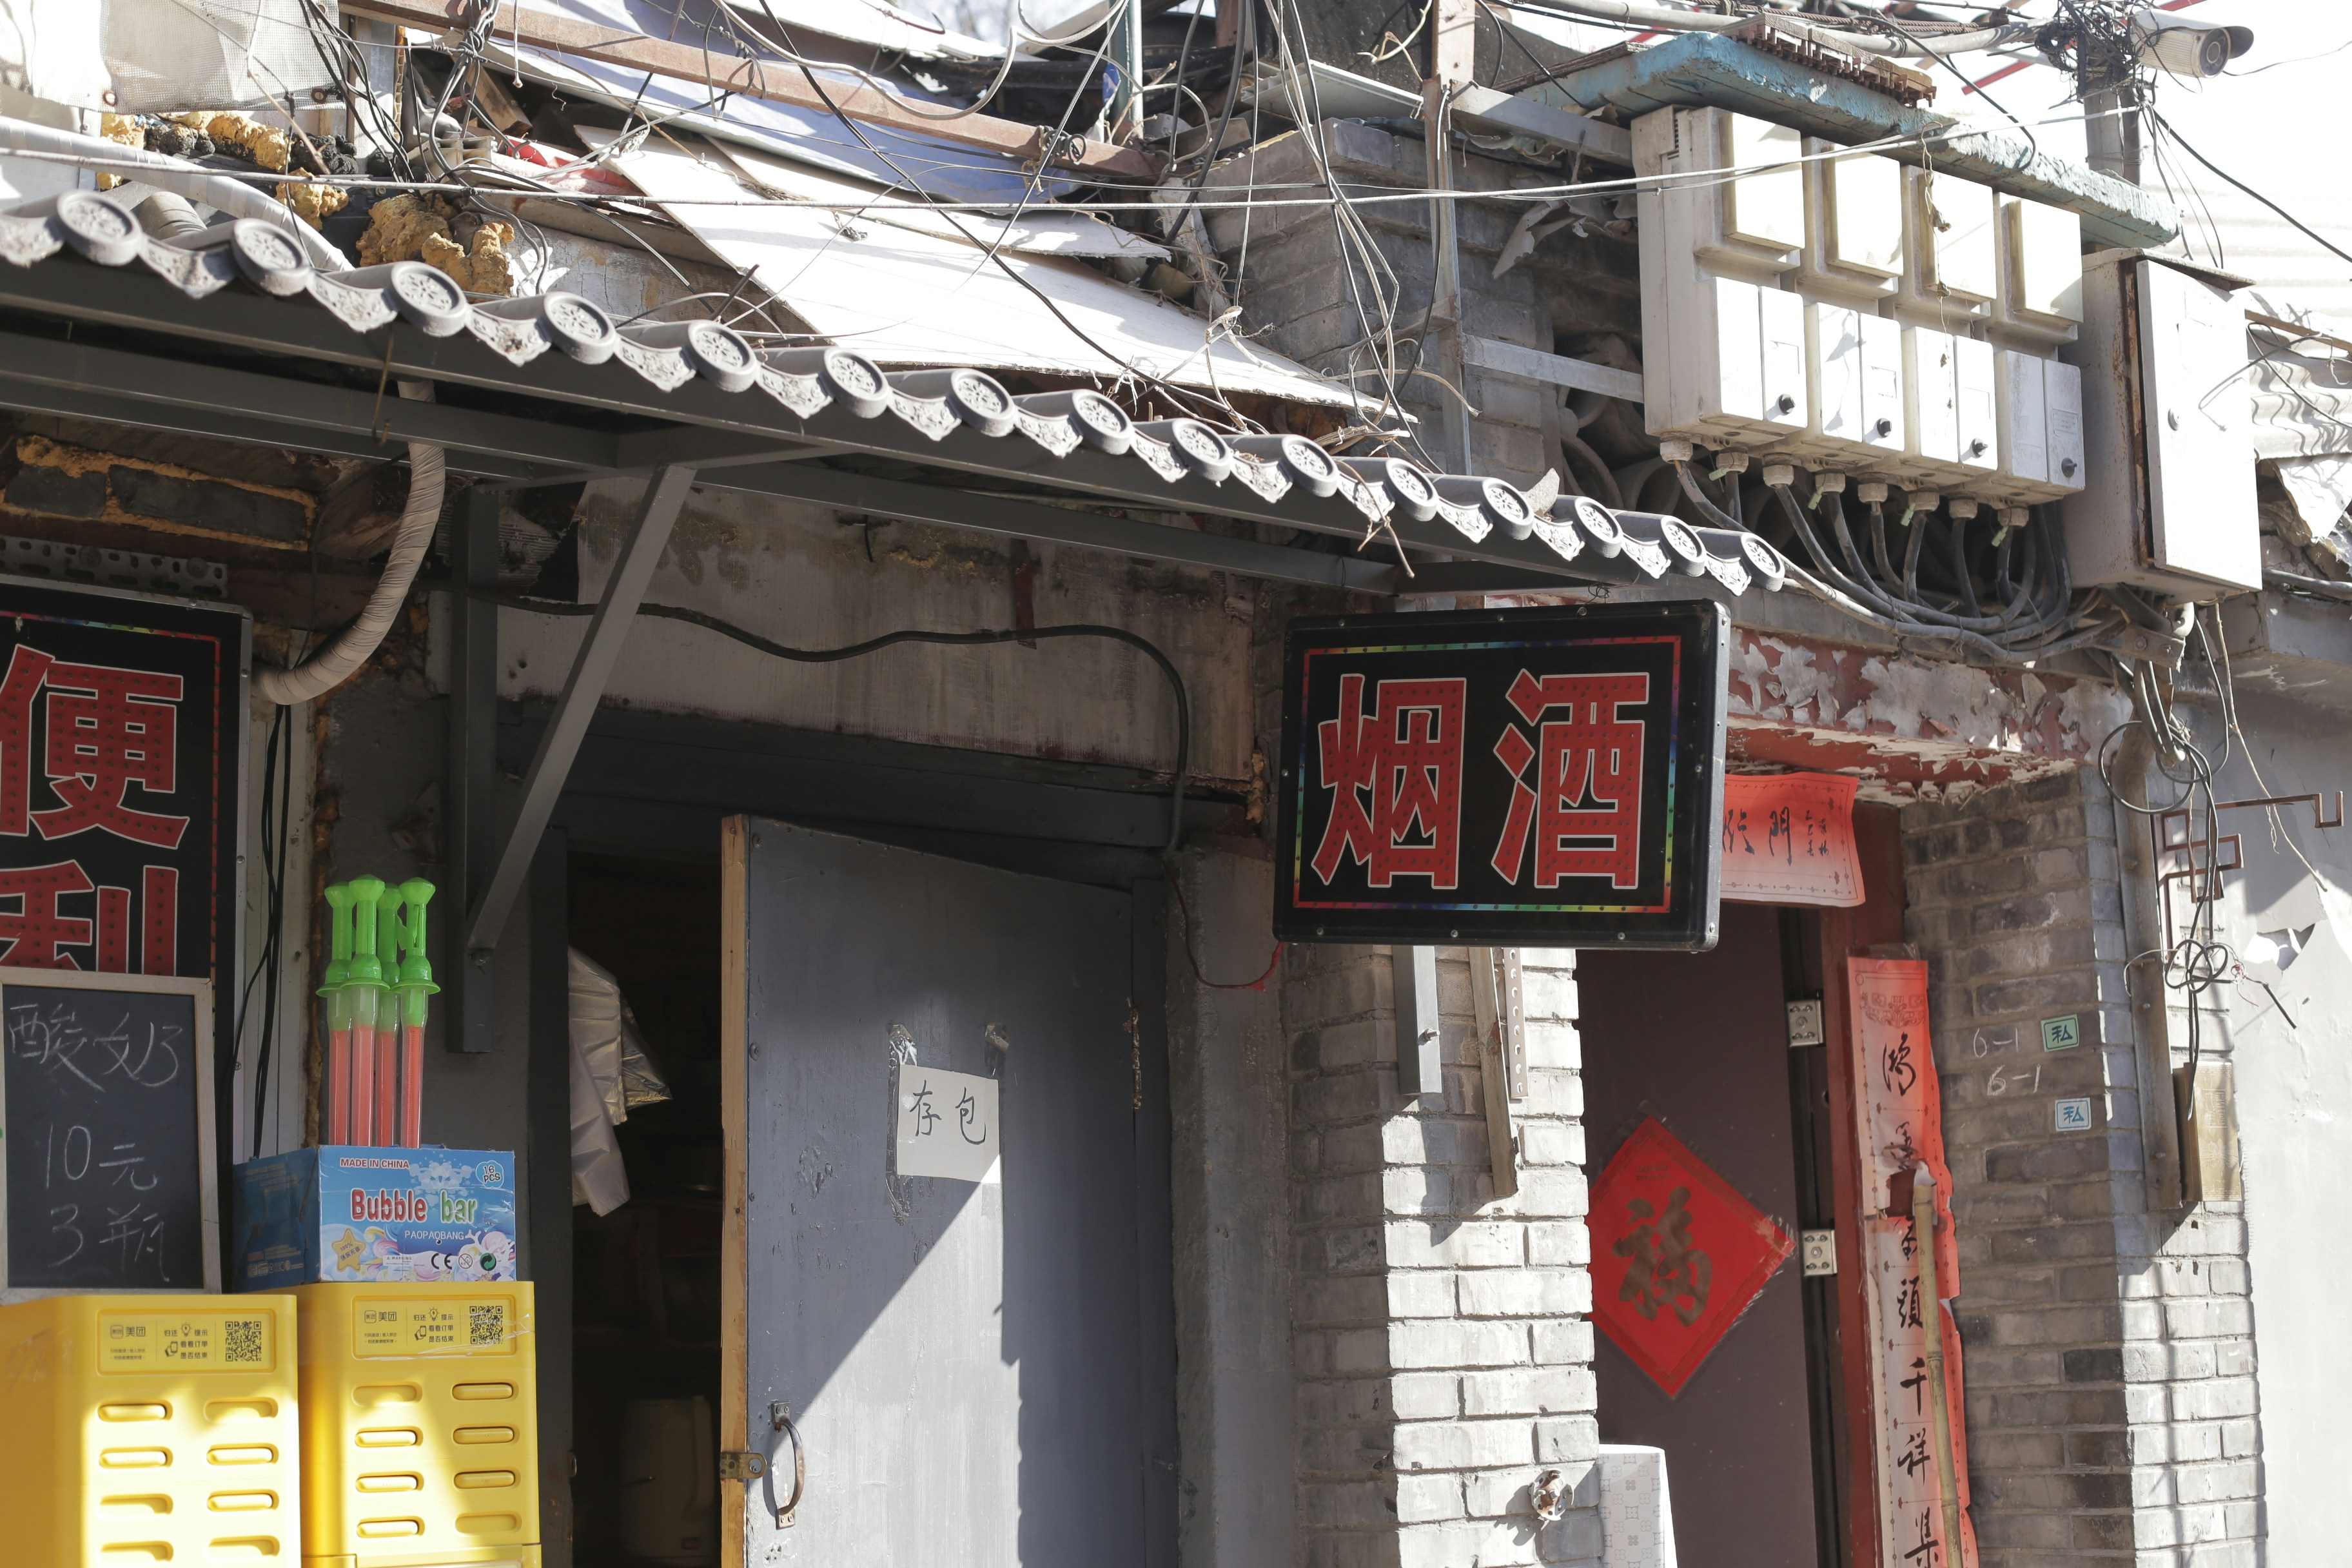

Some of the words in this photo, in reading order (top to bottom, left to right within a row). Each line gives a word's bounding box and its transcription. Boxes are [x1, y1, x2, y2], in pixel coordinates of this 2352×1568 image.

[1311, 669, 1649, 889] 烟酒
[1974, 1028, 2019, 1058] 6-1
[2051, 1024, 2073, 1044] 私
[8, 1003, 183, 1093] 酸奶
[1986, 1064, 2041, 1095] 6-1
[909, 1079, 987, 1146] 存包
[2063, 1106, 2084, 1124] 私
[45, 1123, 159, 1191] 10元
[340, 1158, 367, 1168] MADE
[368, 1159, 379, 1168] IN
[381, 1159, 409, 1169] CHINA
[483, 1173, 501, 1183] PCS
[484, 1165, 495, 1175] 16
[351, 1188, 428, 1222] Bubble
[440, 1188, 478, 1224] bar
[48, 1202, 170, 1282] 3瓶
[404, 1230, 464, 1240] PAOPAOBANG
[431, 1253, 453, 1270] CE
[1612, 1186, 1712, 1327] 福
[378, 1311, 397, 1322] 美团
[125, 1326, 146, 1337] 美团
